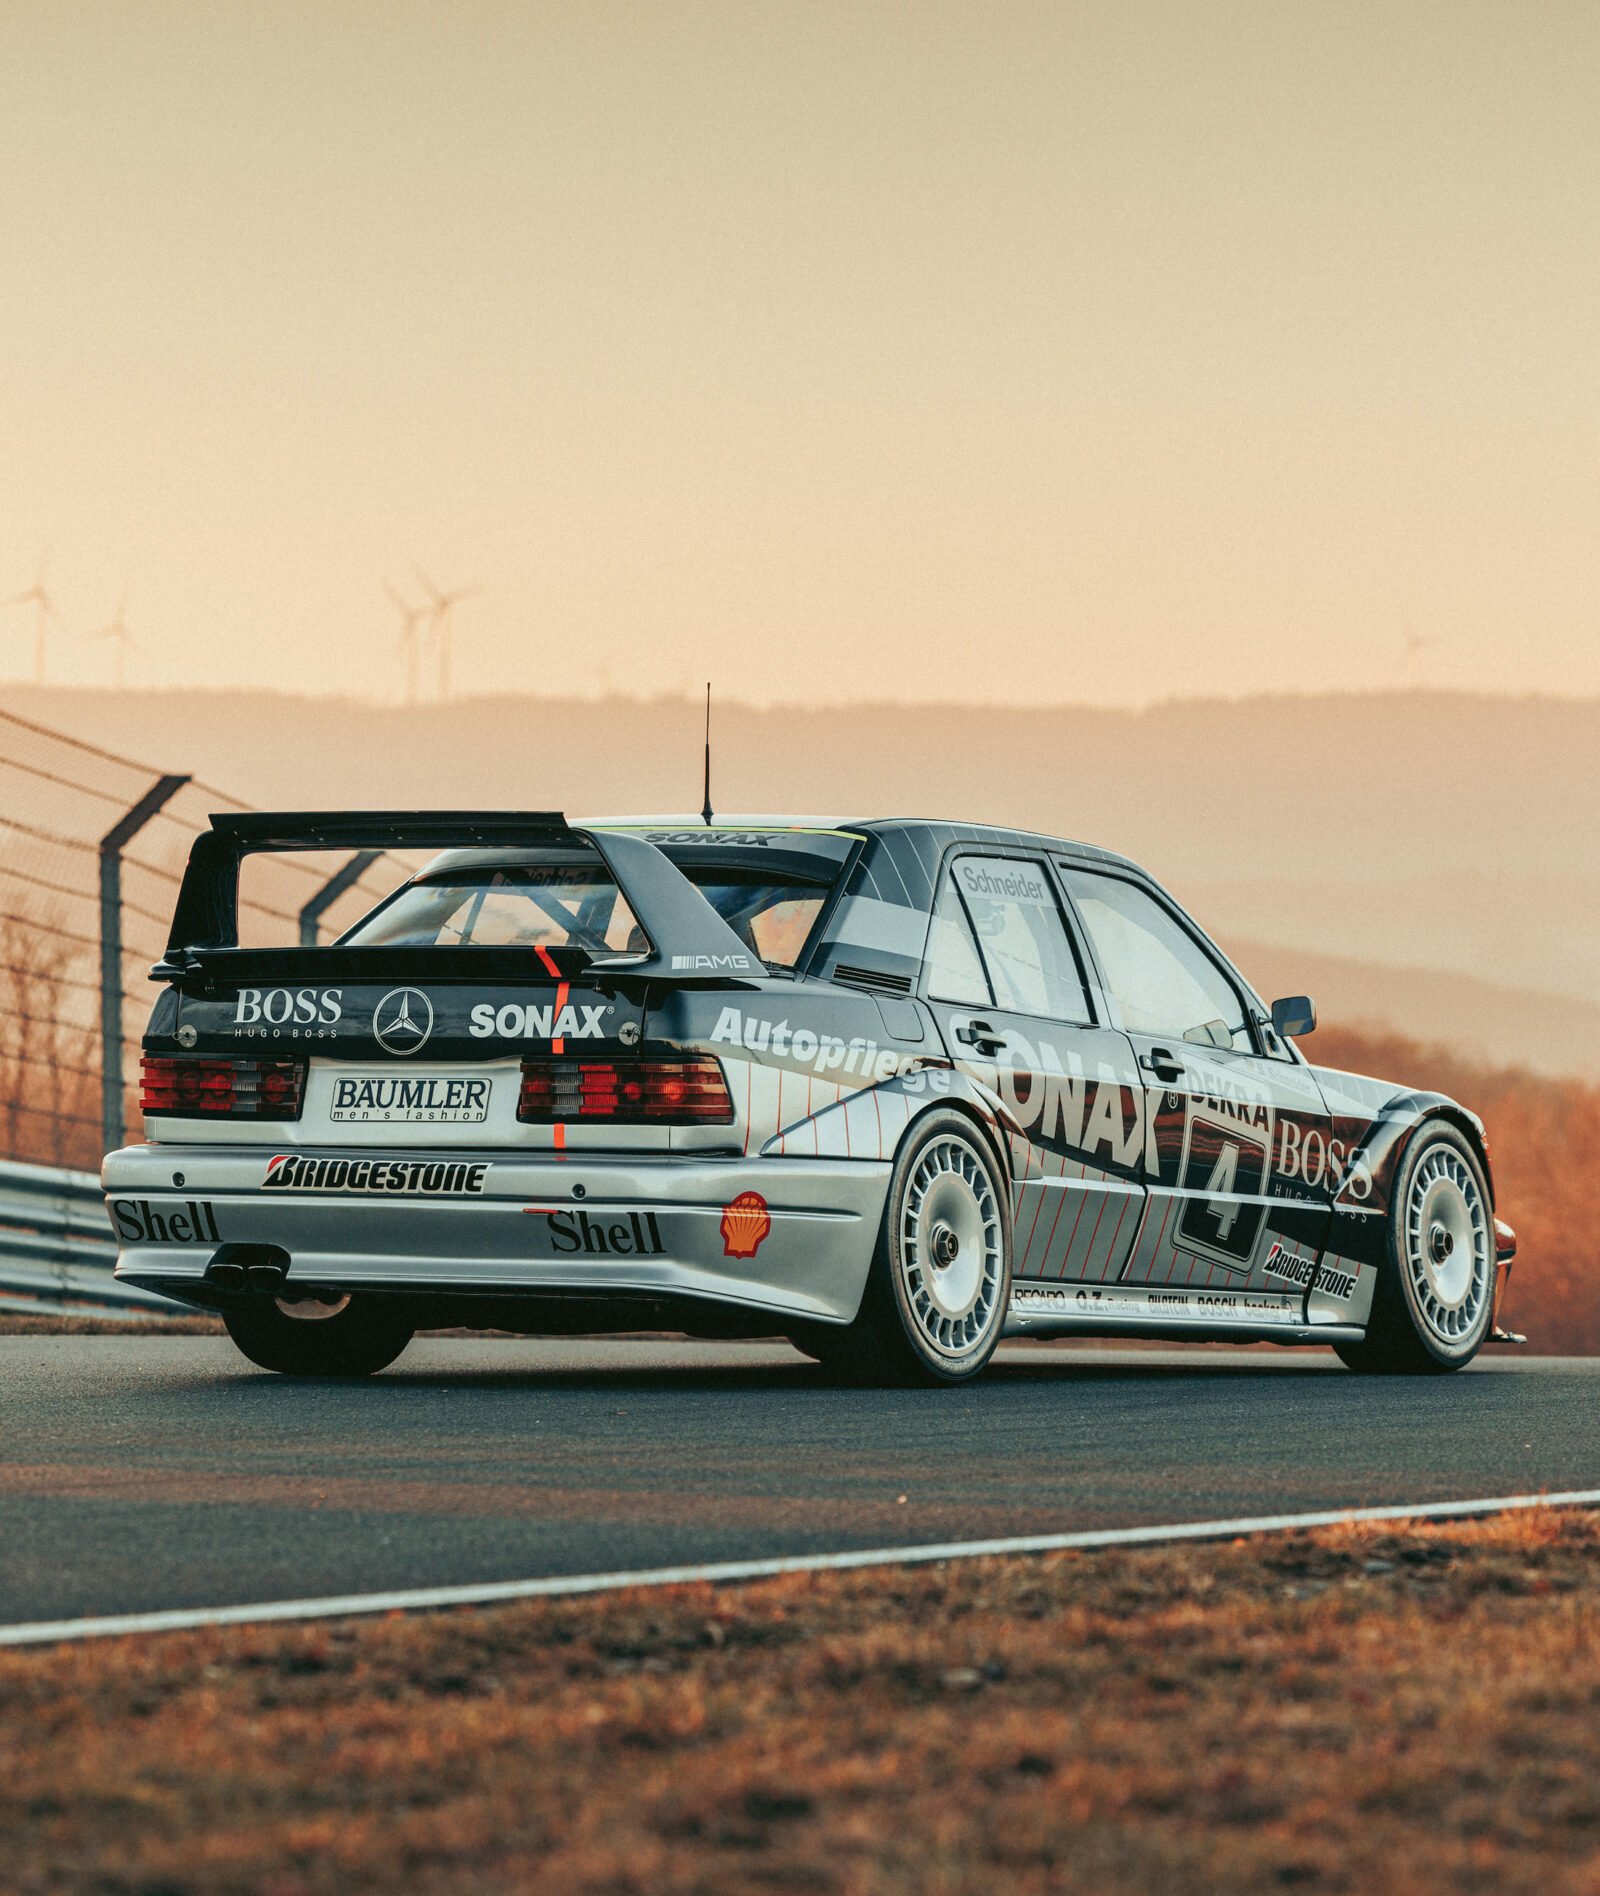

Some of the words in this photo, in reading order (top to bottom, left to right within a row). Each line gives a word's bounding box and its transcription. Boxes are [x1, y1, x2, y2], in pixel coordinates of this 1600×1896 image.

[645, 832, 779, 847] SONAX
[962, 865, 1044, 900] Schneider
[694, 955, 750, 969] AMG
[233, 988, 343, 1024] BOSS
[234, 1028, 280, 1039] HUGO
[292, 1028, 338, 1039] BOSS
[709, 1006, 951, 1093] Autopflege
[334, 1079, 487, 1109] BÄUMLER
[1185, 1065, 1270, 1133] DEKRA
[405, 1108, 483, 1121] fashion
[261, 1156, 488, 1193] BRIDGESTONE
[1276, 1117, 1373, 1200] BOSS
[1206, 1140, 1240, 1241] 4
[112, 1199, 224, 1243] Shell
[545, 1209, 667, 1254] Shell
[1263, 1242, 1358, 1300] BRIDGESTONE
[1197, 1296, 1239, 1317] BOSCH
